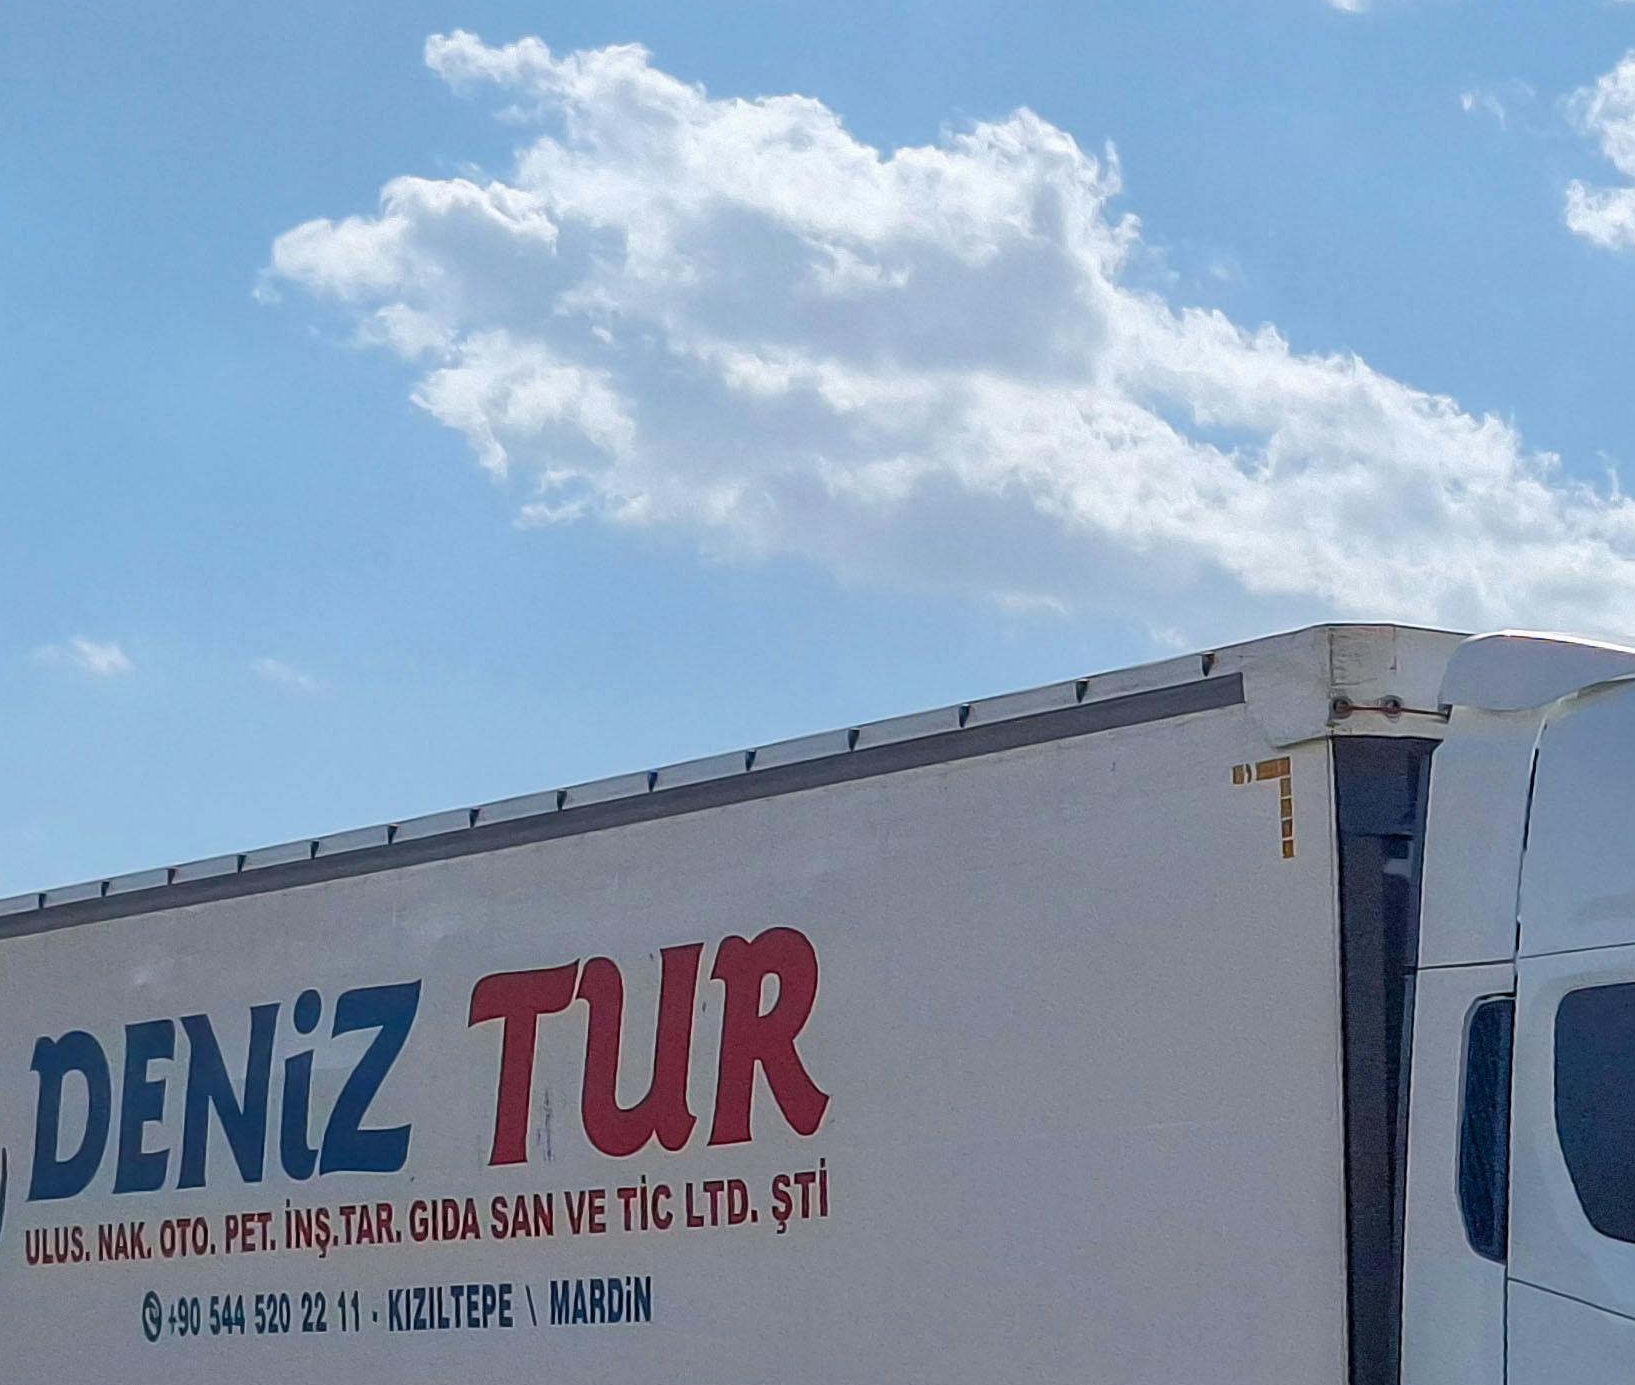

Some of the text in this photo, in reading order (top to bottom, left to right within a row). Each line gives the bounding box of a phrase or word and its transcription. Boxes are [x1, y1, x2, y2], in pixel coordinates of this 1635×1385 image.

[468, 926, 830, 1167] TUR
[25, 1225, 90, 1265] ULUS.
[98, 1221, 152, 1261] NAK.
[160, 1216, 215, 1258] OTO.
[225, 1212, 276, 1254] PET.
[409, 1198, 481, 1242] GIDA
[490, 1193, 554, 1239] SAN
[564, 1189, 607, 1235] VE
[617, 1175, 673, 1232] TİC
[685, 1178, 758, 1228] LTD.
[771, 1158, 828, 1234] ŞTİ
[168, 1297, 201, 1336] +90
[209, 1294, 246, 1335] 544
[255, 1293, 291, 1334] 520
[301, 1291, 327, 1333] 22
[337, 1290, 360, 1332] 11
[388, 1284, 513, 1332] KIZILTEPE
